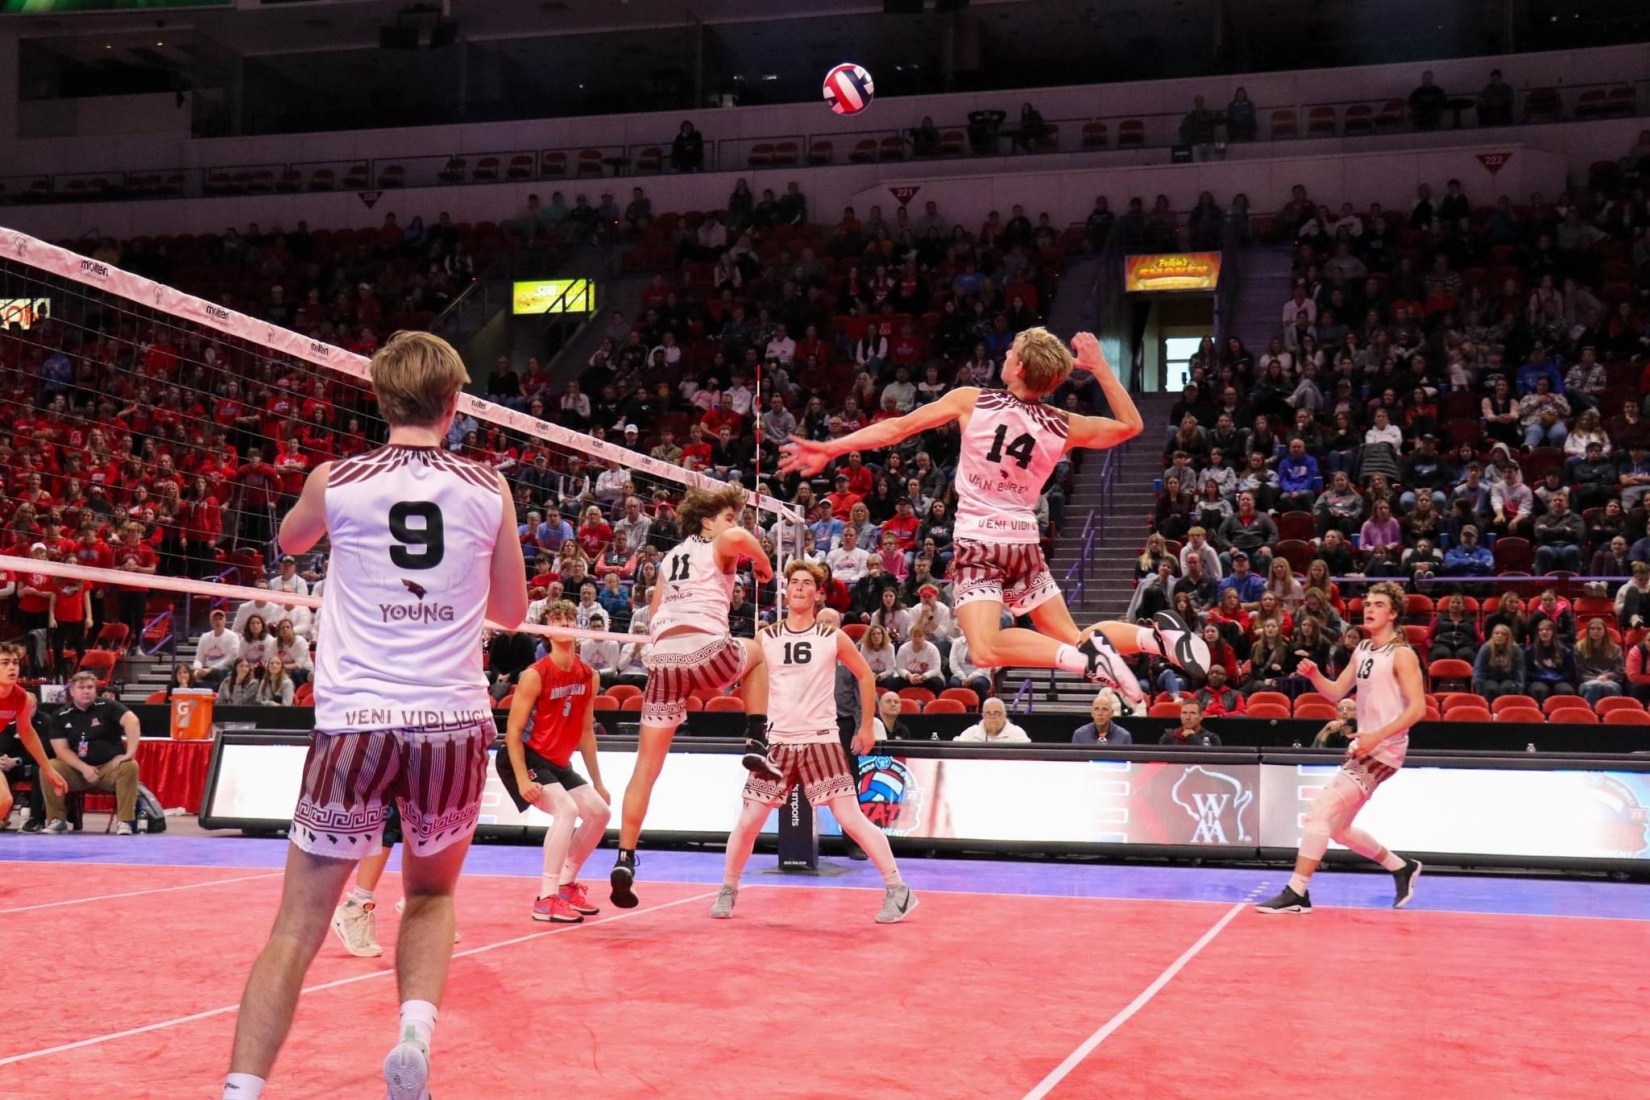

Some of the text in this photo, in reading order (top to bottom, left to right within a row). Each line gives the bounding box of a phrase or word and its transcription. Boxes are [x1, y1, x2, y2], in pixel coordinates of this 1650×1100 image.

[896, 188, 913, 197] 221
[80, 259, 109, 277] molten
[985, 423, 1037, 470] 14
[968, 472, 994, 491] VAN
[388, 500, 445, 570] 9
[978, 518, 1007, 531] VENI
[668, 553, 690, 582] 11
[378, 602, 455, 625] YOUNG
[783, 641, 812, 665] 16
[1356, 658, 1374, 680] 13
[177, 701, 189, 716] G
[345, 708, 393, 726] VENI
[401, 710, 444, 728] VIDI
[789, 792, 800, 827] imports
